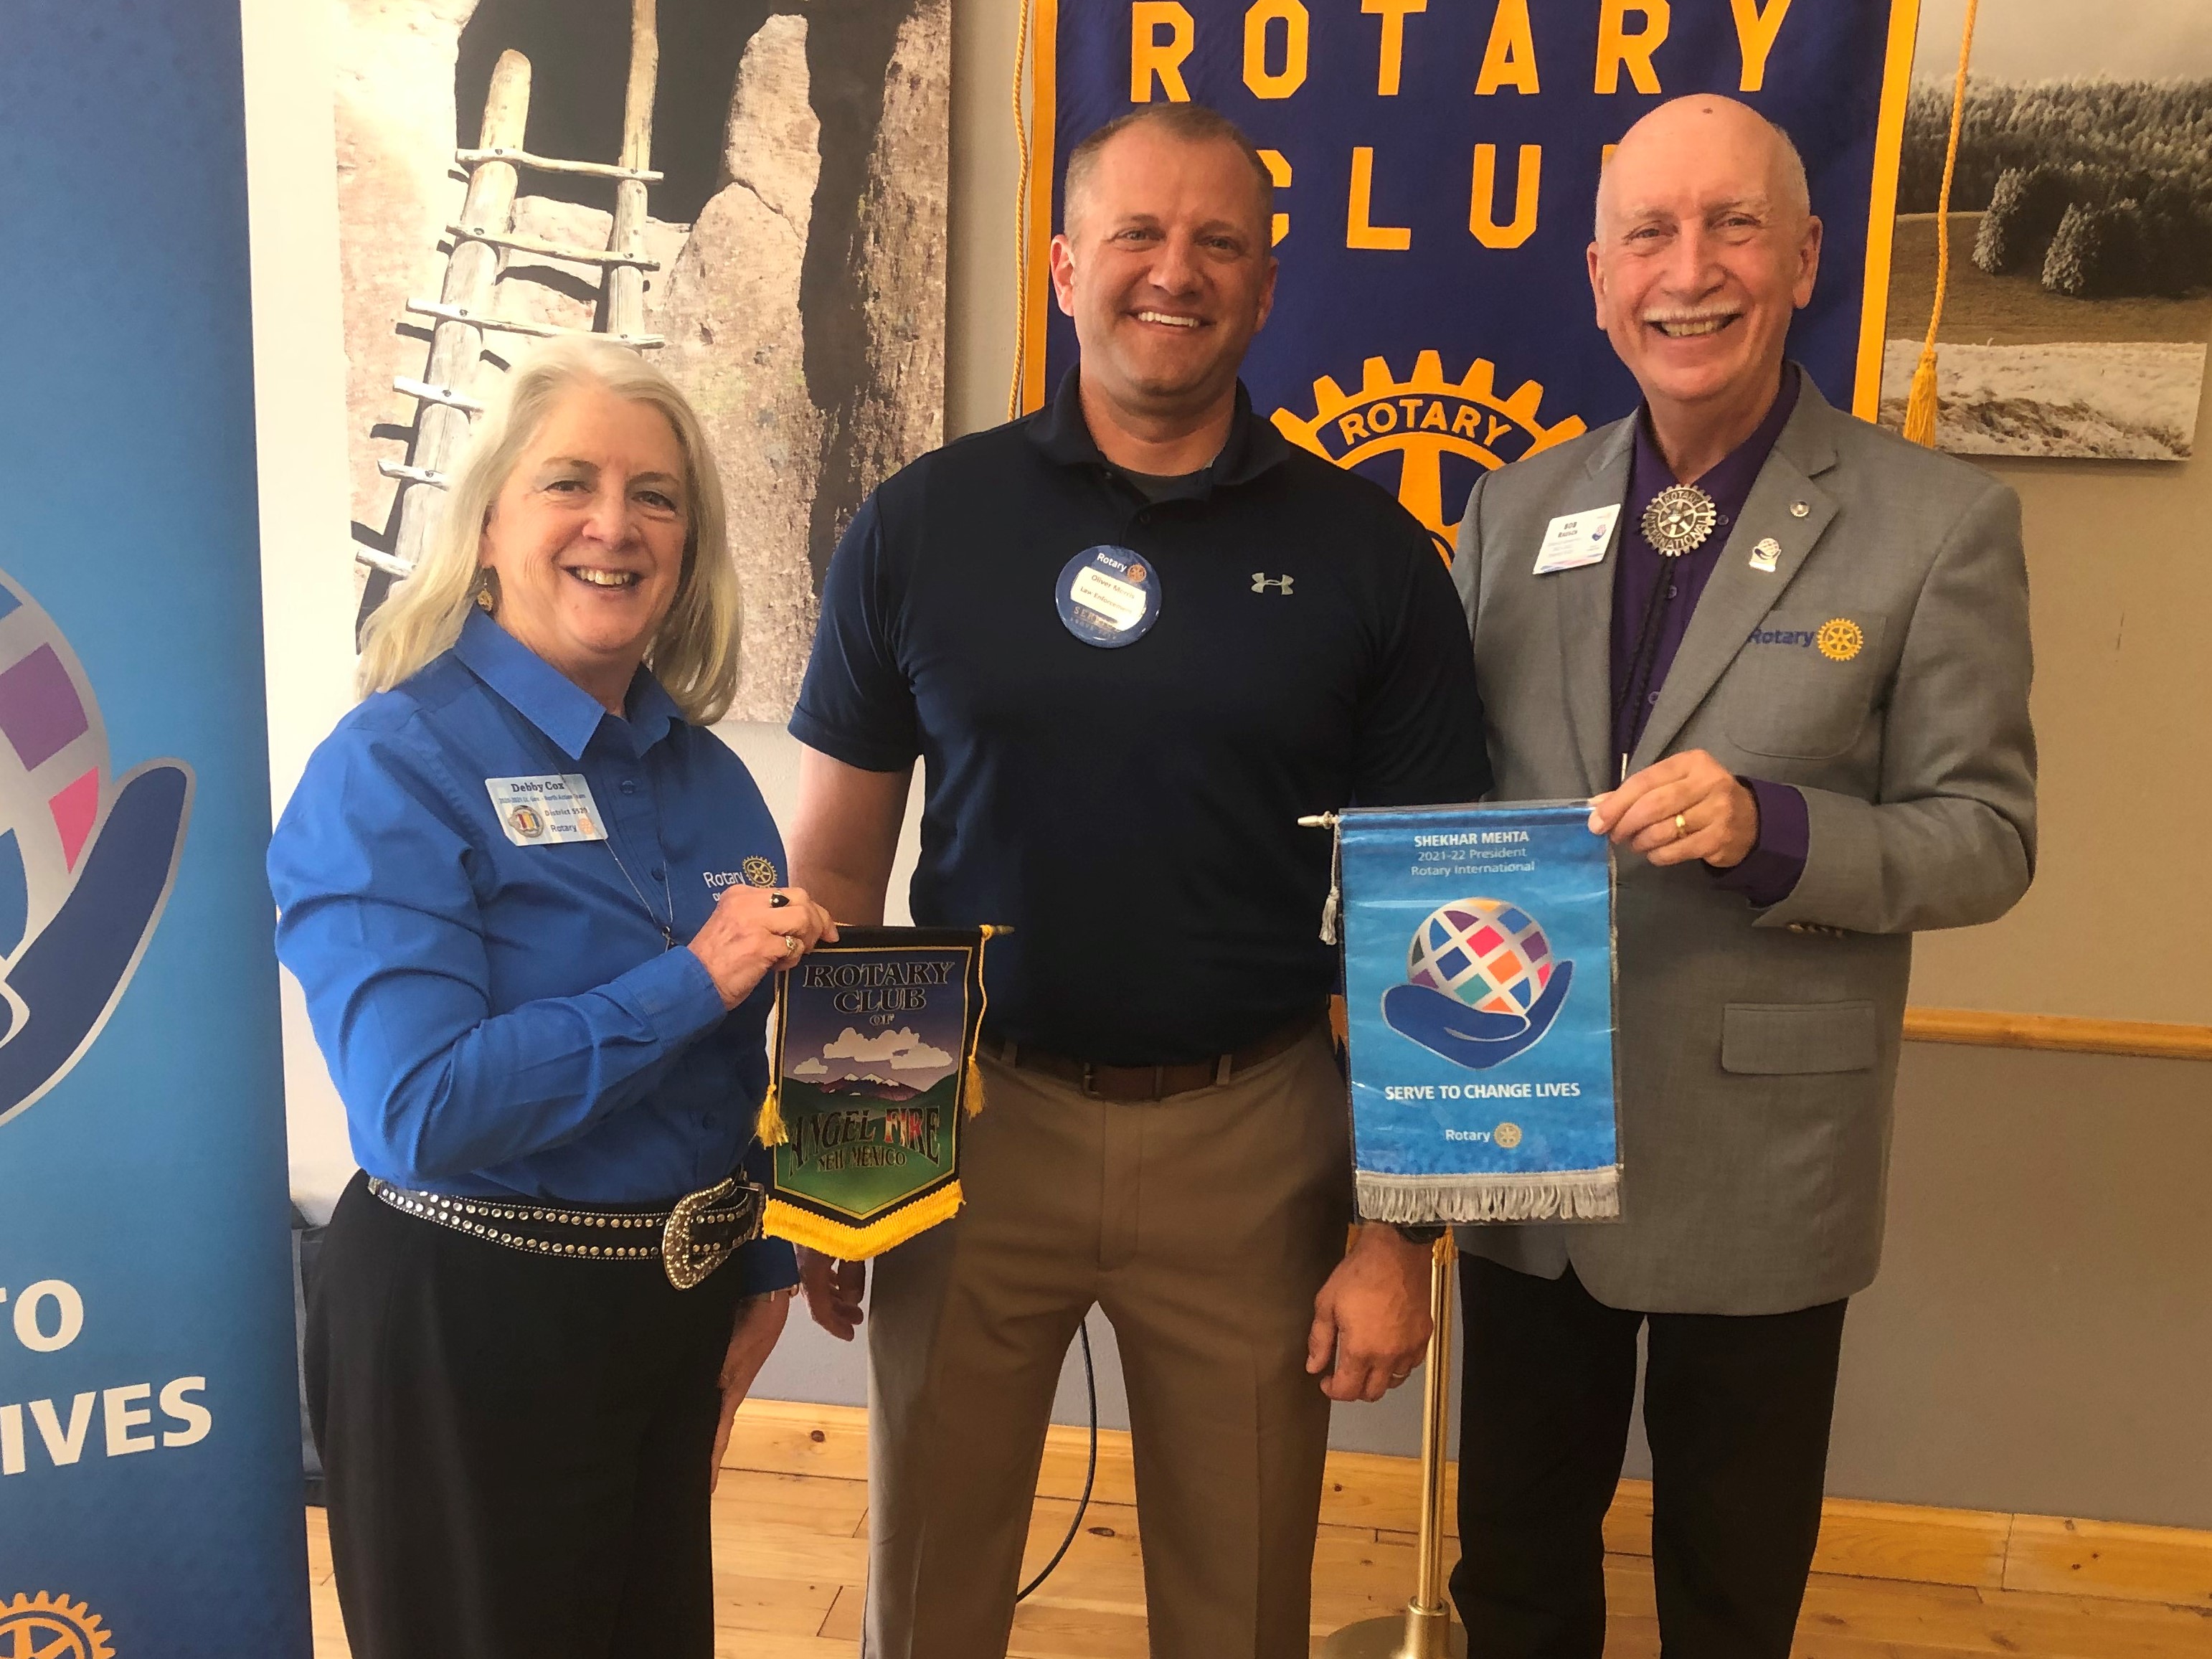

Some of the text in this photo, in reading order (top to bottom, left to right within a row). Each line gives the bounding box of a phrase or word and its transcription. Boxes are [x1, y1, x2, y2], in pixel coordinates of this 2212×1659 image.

[1130, 0, 1792, 103] ROTARY
[1257, 143, 1619, 251] LU
[1338, 398, 1513, 446] ROTARY
[1664, 491, 1701, 504] ROTARY
[1648, 513, 1707, 549] INTERNATIONAL
[1097, 552, 1128, 572] Rotary
[1079, 586, 1092, 595] Law
[1091, 575, 1111, 587] Oliver
[1751, 628, 1814, 648] Rotary
[511, 781, 565, 793] Debby Cox
[551, 824, 577, 833] Rotary
[1414, 831, 1530, 847] SHEKHAR MEHTA
[1418, 847, 1527, 861] 2021-22 President
[1411, 861, 1535, 877] Rotary International
[703, 871, 746, 888] Rotary
[803, 961, 955, 988] ROTARY
[833, 988, 927, 1014] CLUB
[869, 1013, 894, 1026] OF
[1384, 1082, 1581, 1101] SERVE TO CHANGE LIVES
[788, 1105, 940, 1178] ANGEL FIRE
[1445, 1128, 1490, 1145] Rotary
[849, 1145, 907, 1168] MEXICO
[0, 1280, 84, 1352] O
